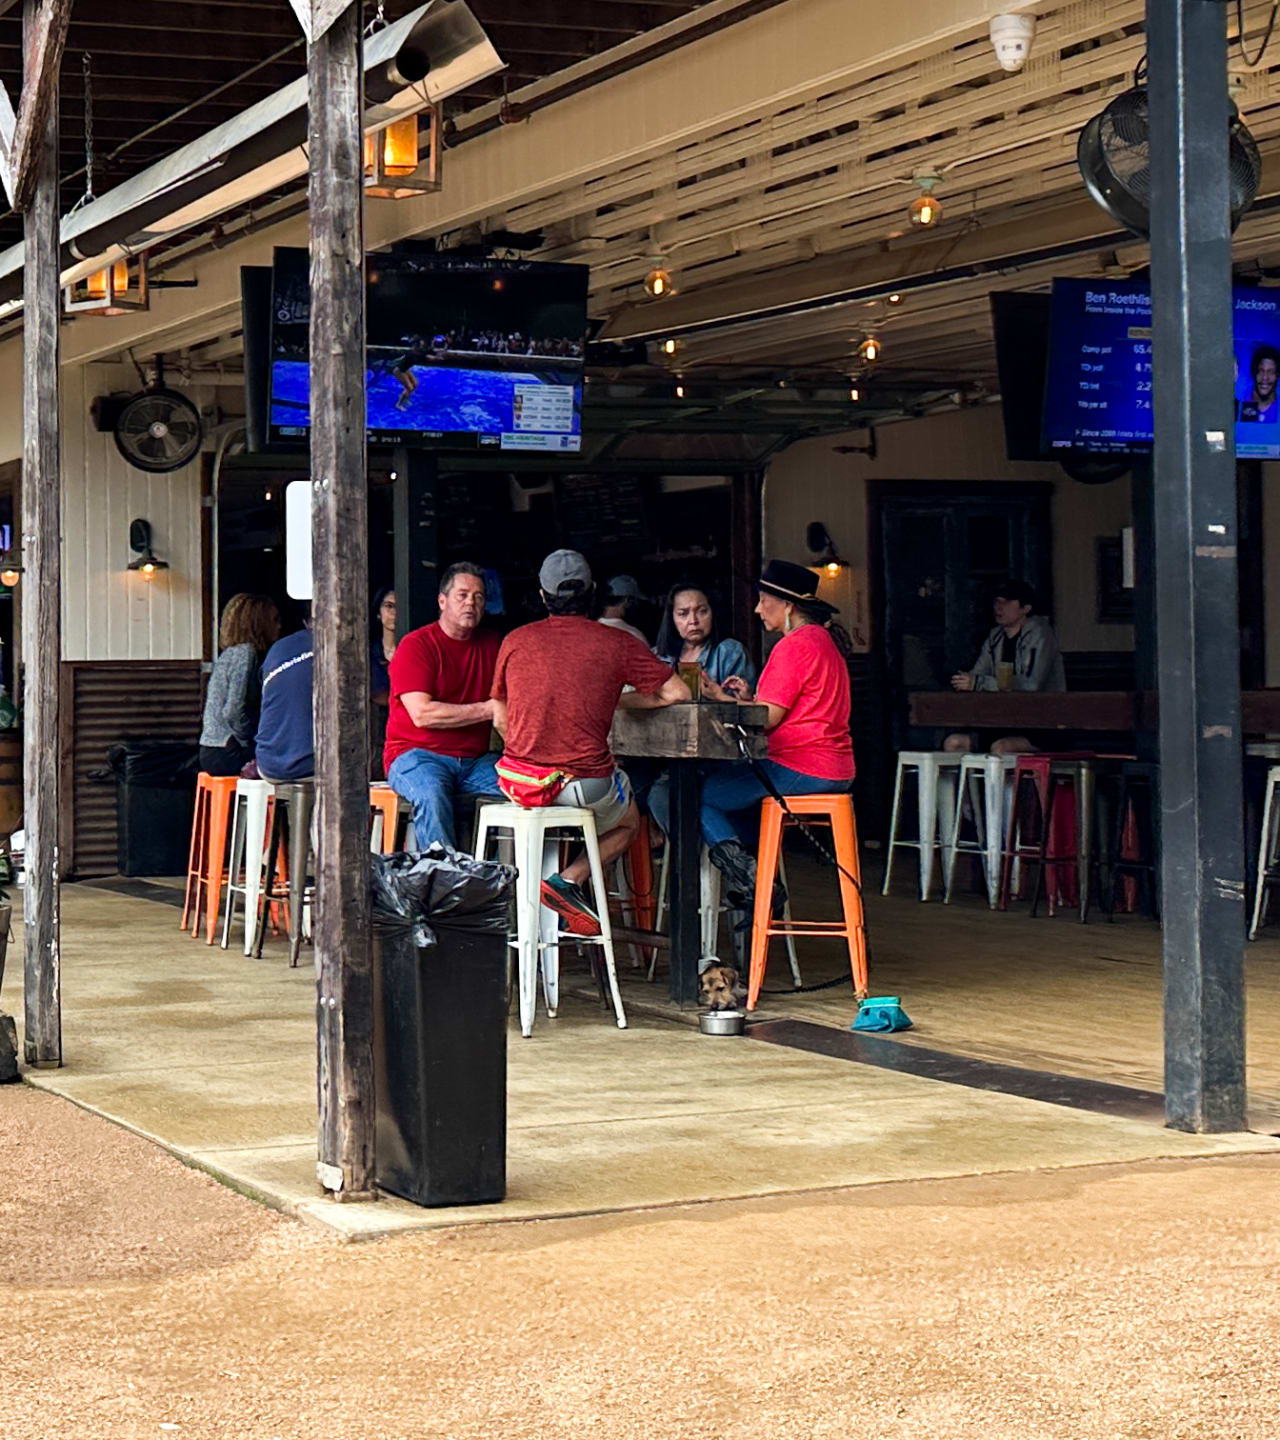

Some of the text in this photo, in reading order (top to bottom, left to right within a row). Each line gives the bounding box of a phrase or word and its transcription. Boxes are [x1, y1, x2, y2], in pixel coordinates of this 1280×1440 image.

[1085, 291, 1151, 306] Ben Roethlis
[1235, 299, 1277, 311] Jackson
